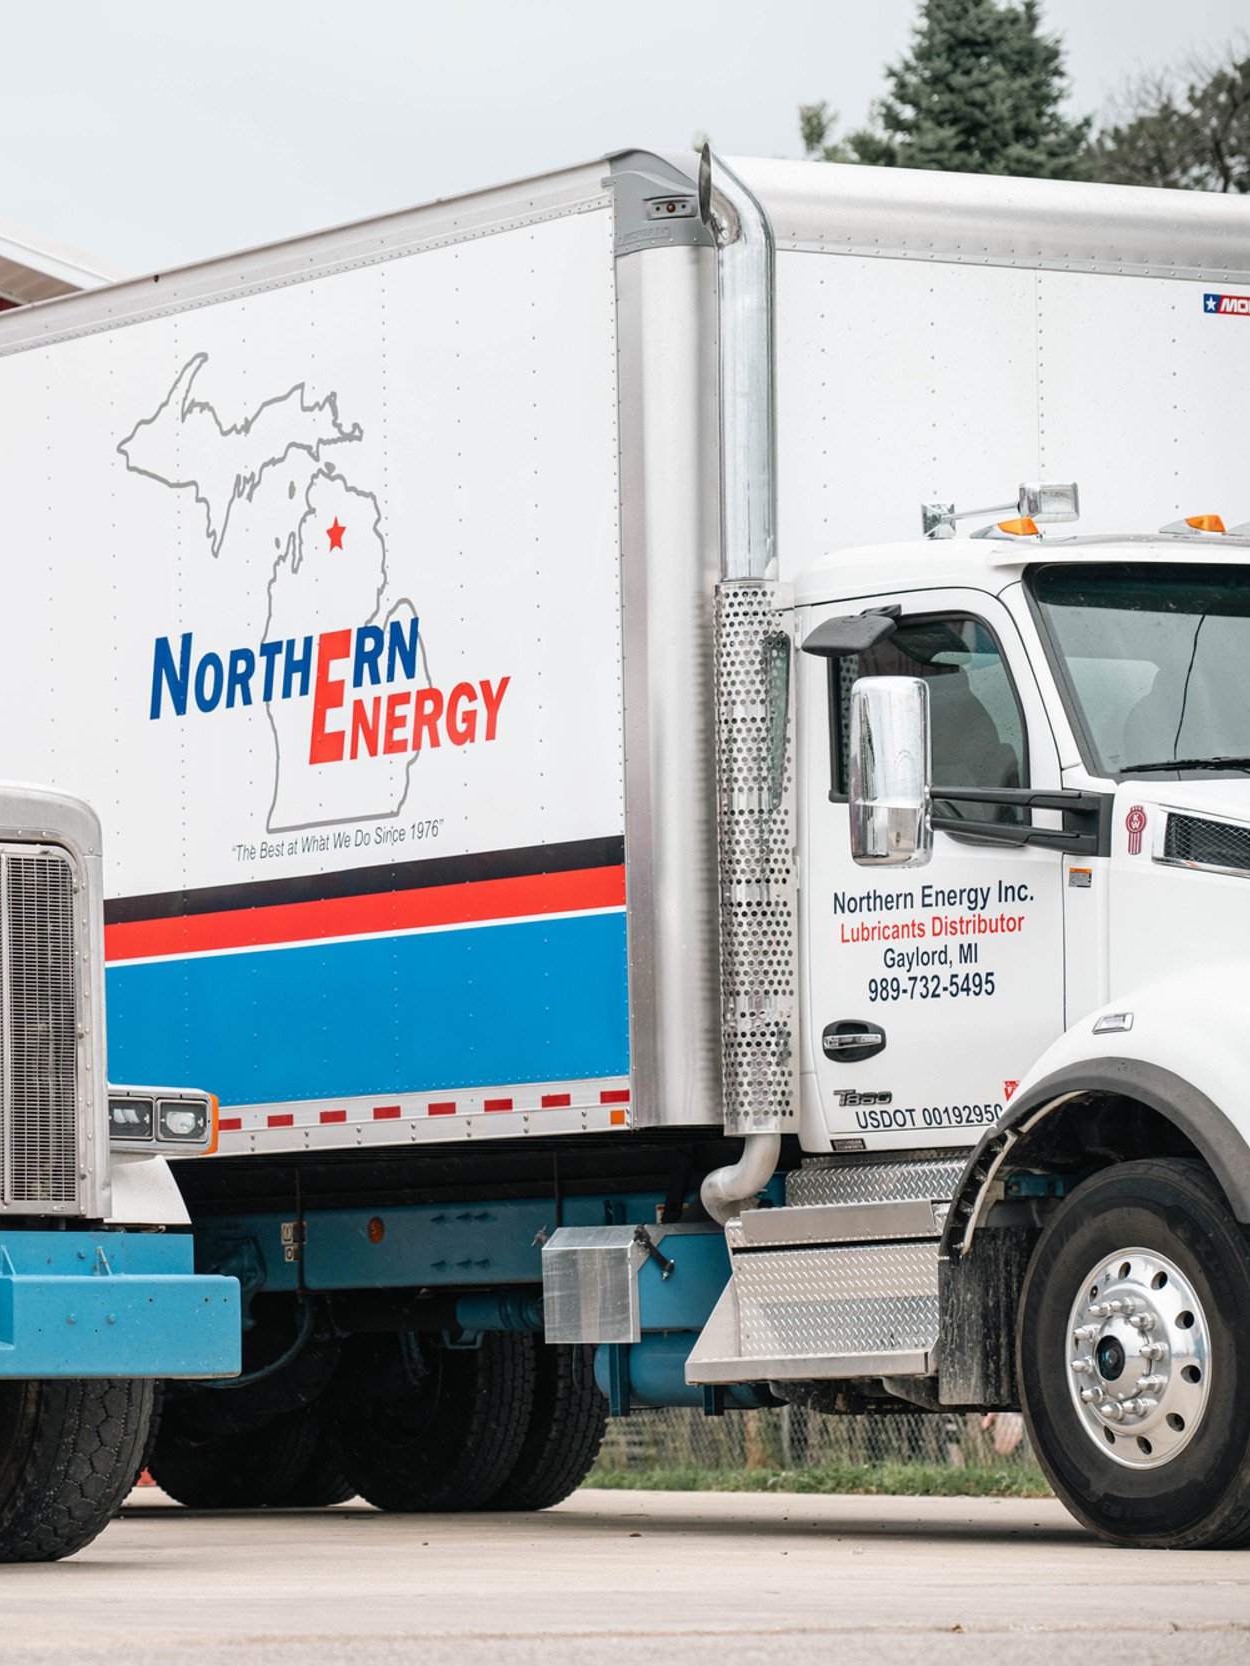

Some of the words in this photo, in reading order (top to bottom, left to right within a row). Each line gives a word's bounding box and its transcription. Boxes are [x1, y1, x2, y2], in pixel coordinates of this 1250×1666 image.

[1219, 297, 1250, 314] MO
[150, 617, 419, 722] NORTHERN
[309, 677, 511, 765] ENERGY
[259, 840, 285, 860] Best
[287, 838, 299, 856] at
[301, 834, 330, 854] What
[333, 831, 352, 850] We
[354, 828, 371, 848] Do
[374, 825, 407, 845] Since
[833, 889, 914, 915] Northern
[921, 884, 991, 912] Energy
[998, 879, 1034, 904] Inc.
[840, 919, 926, 943] Lubricants
[931, 913, 1025, 937] Distributor
[883, 944, 953, 973] Gaylord,
[958, 942, 978, 965] MI
[868, 971, 996, 1003] 989-732-5495
[855, 1108, 917, 1131] USDOT
[922, 1103, 1003, 1127] 00192950
